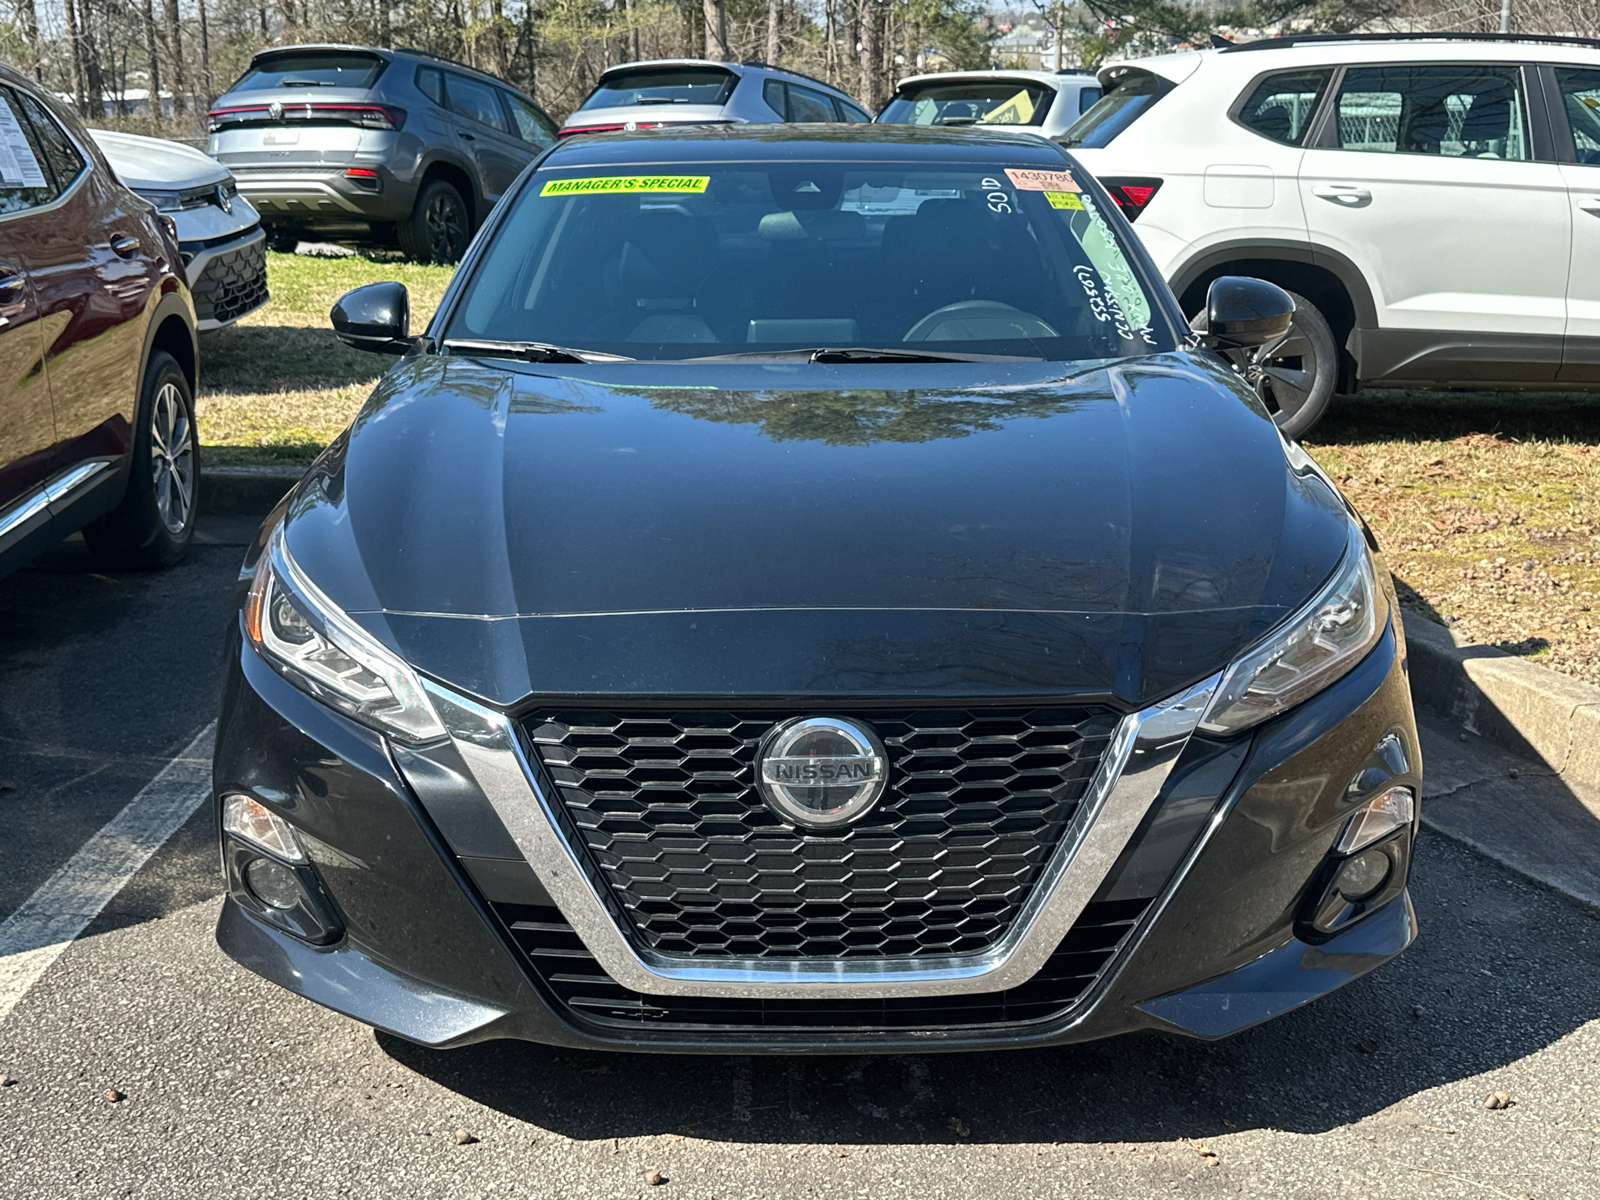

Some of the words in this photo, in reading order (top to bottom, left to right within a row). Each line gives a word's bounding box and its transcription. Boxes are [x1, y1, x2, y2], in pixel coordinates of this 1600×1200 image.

[546, 178, 638, 193] MANAGER'S
[638, 177, 704, 191] SPECIAL
[1010, 171, 1074, 184] 1430780
[775, 763, 870, 779] NISSAN
